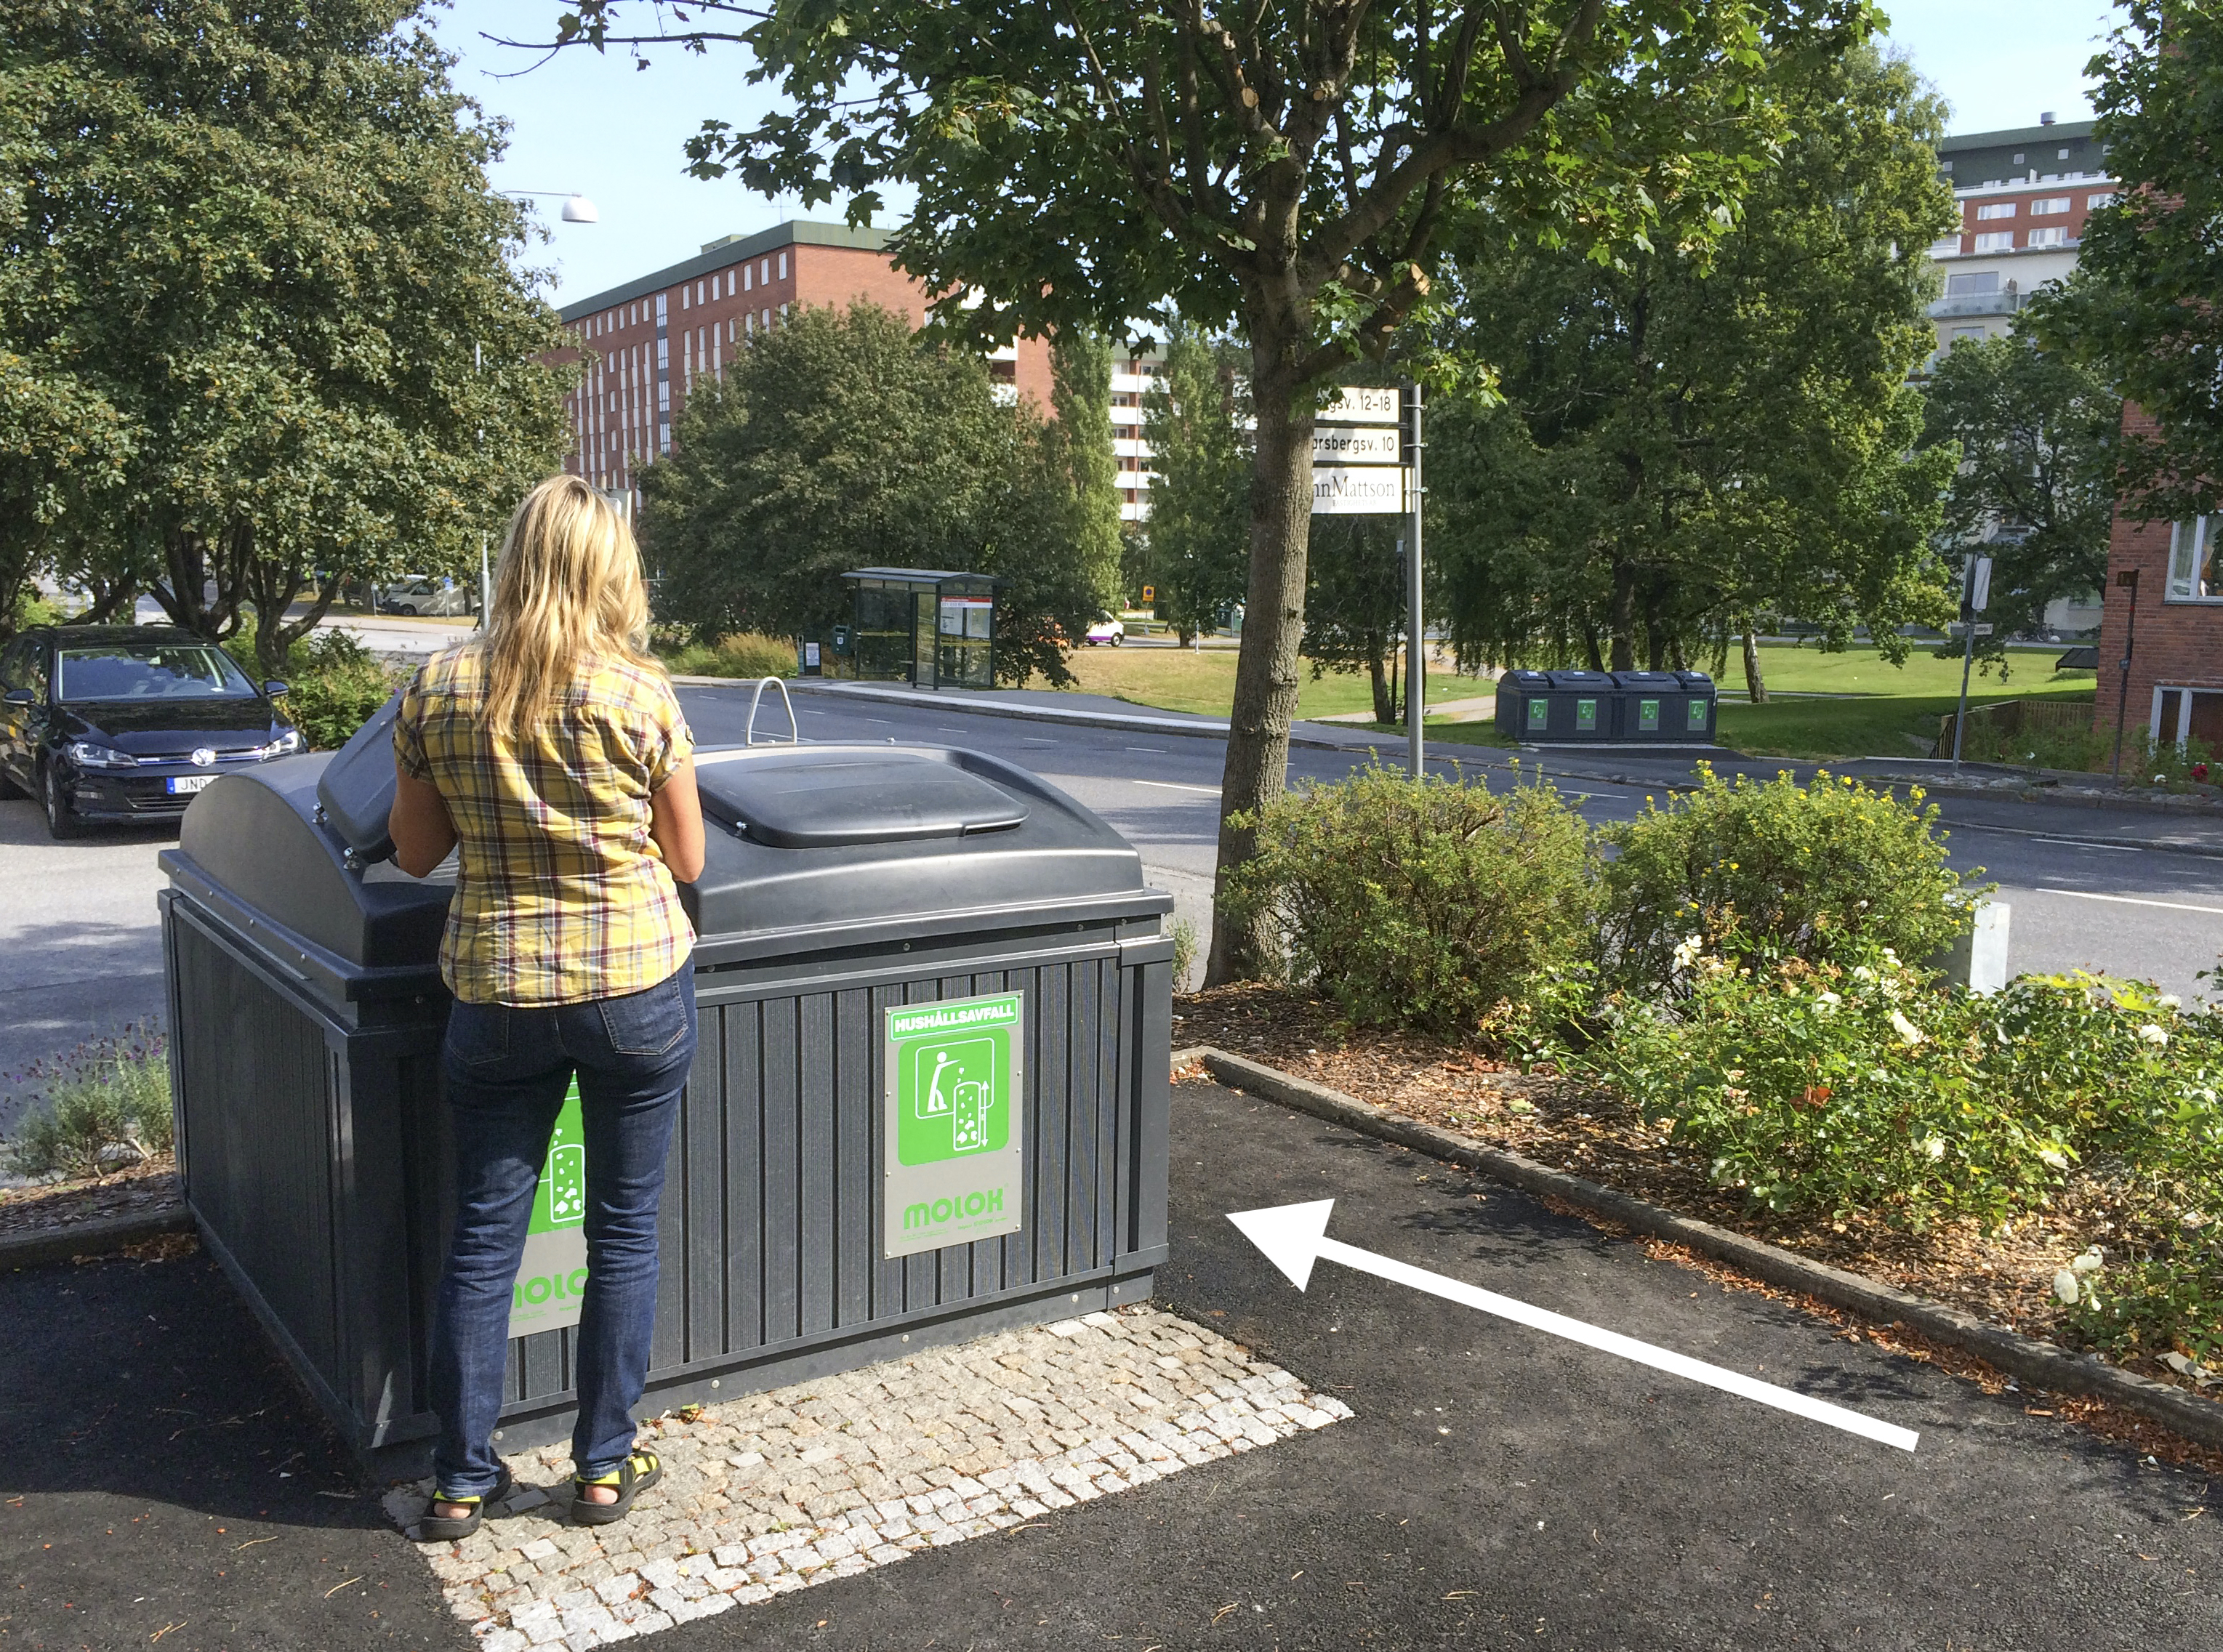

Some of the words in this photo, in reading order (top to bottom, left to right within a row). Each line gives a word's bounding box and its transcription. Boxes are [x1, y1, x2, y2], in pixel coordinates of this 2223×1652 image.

[1330, 398, 1355, 413] gsv.
[1360, 395, 1391, 411] 12-18
[1312, 435, 1378, 454] arsbergsv.
[1382, 436, 1394, 451] 10
[895, 1004, 1014, 1033] HUSHÅLLSAVFALL
